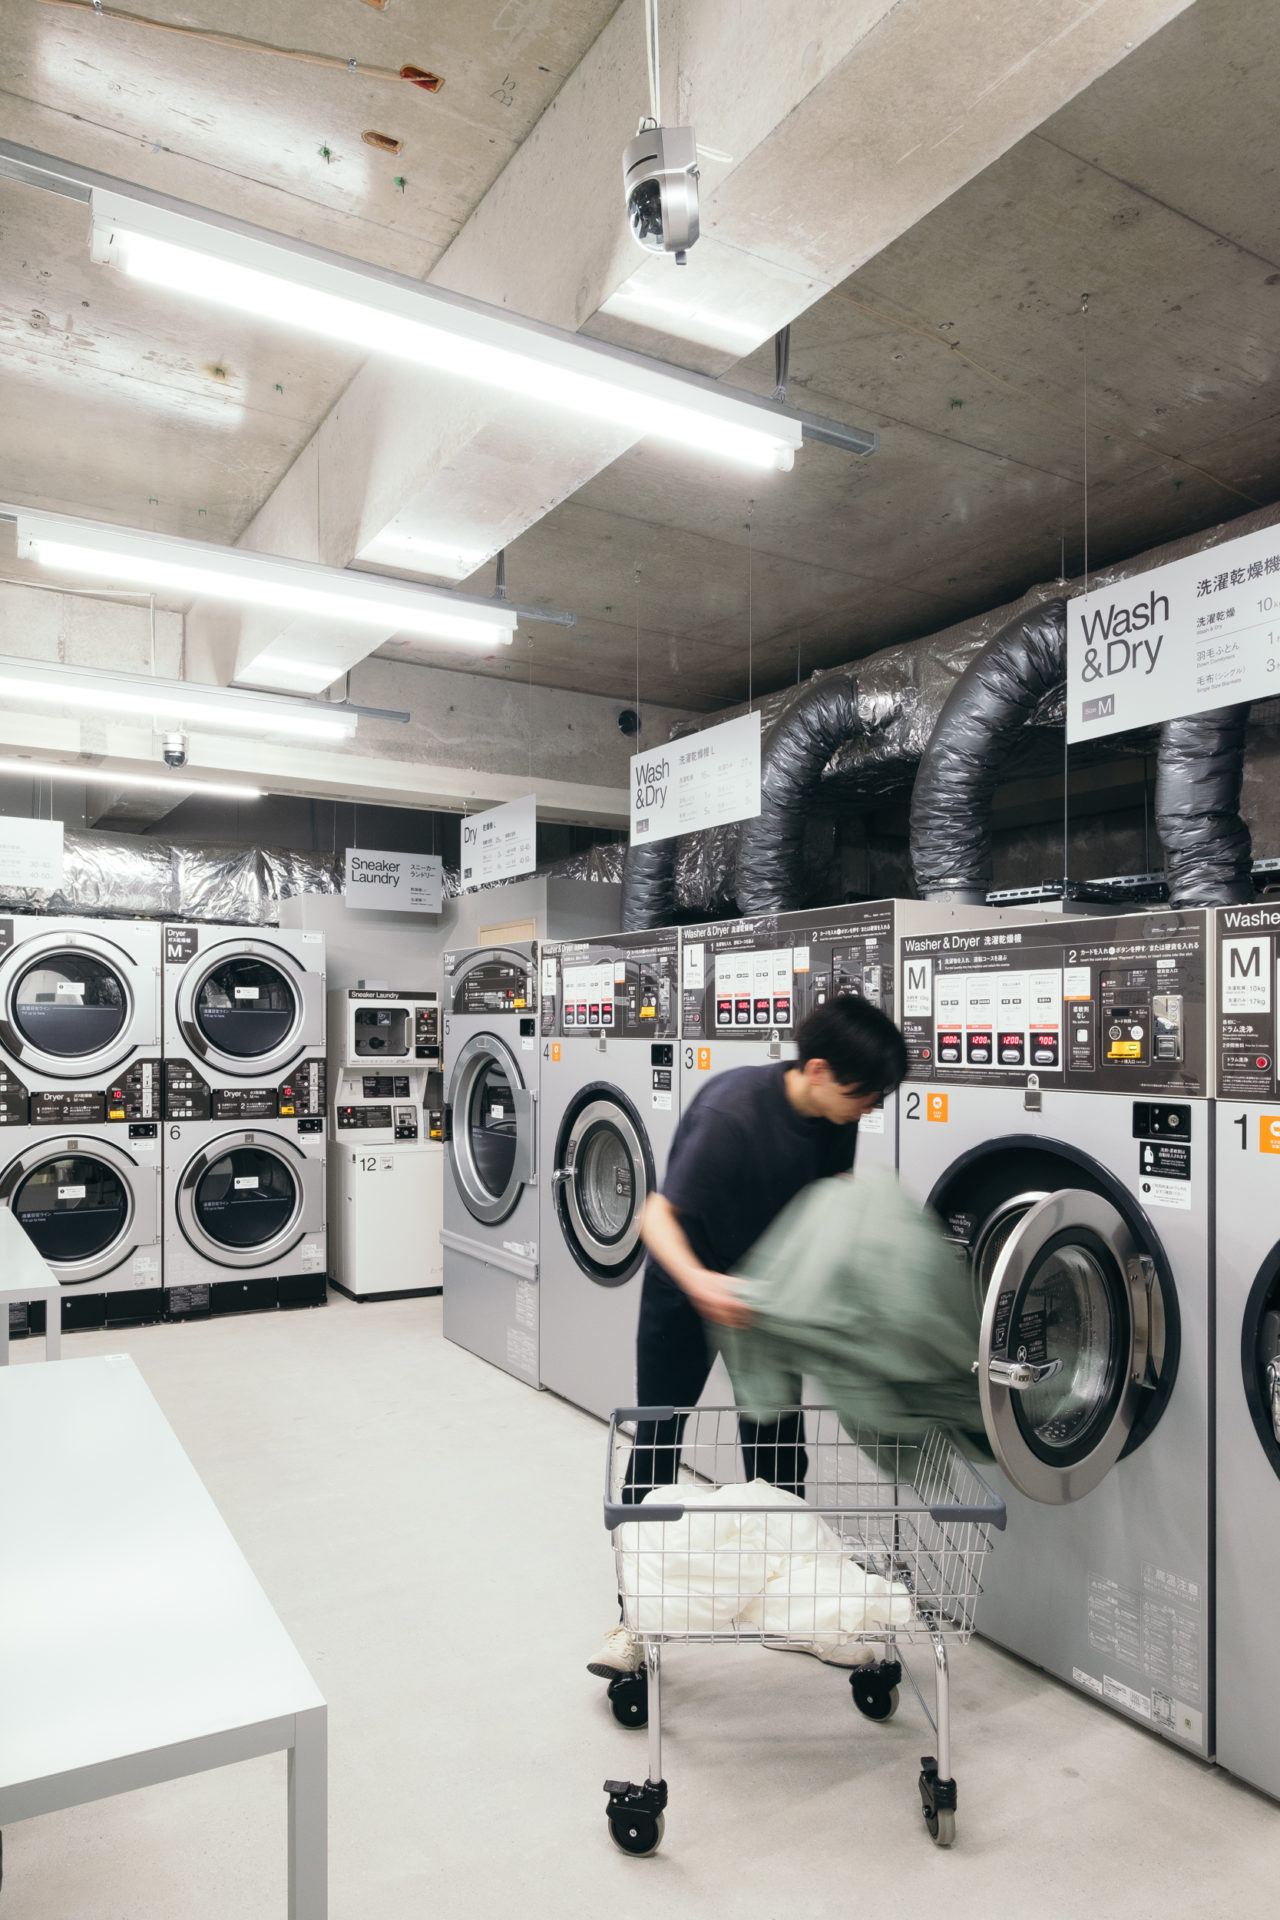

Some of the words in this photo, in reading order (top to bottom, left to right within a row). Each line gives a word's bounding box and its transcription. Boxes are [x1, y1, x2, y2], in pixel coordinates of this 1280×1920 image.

[1196, 555, 1280, 598] 洗濯乾燥機
[1081, 591, 1169, 645] Wash
[1197, 642, 1239, 661] 羽毛ふとん
[1098, 699, 1111, 715] M
[636, 758, 669, 786] Wash
[464, 827, 477, 845] Dry
[351, 857, 400, 872] Sneaker
[351, 870, 400, 887] Laundry
[410, 871, 435, 879] ランドリー
[168, 929, 186, 938] Dryer
[684, 929, 706, 939] Washer
[706, 927, 712, 937] &
[712, 926, 730, 937] Dryer
[812, 931, 818, 942] 2
[168, 944, 182, 958] M
[905, 938, 941, 952] Washer
[943, 937, 950, 949] &
[952, 936, 980, 950] Dryer
[984, 934, 1022, 946] 洗濯乾燥機
[690, 949, 697, 967] L
[1068, 950, 1077, 963] 2
[1230, 947, 1260, 978] M
[547, 963, 552, 978] L
[938, 960, 942, 971] 1
[908, 966, 926, 990] M
[445, 1020, 450, 1035] 5
[543, 1043, 550, 1061] 4
[685, 1047, 694, 1069] 3
[44, 1093, 64, 1102] Dryer
[223, 1091, 242, 1099] Dryer
[906, 1092, 920, 1120] 2
[170, 1125, 180, 1140] 6
[1234, 1114, 1247, 1150] 1
[360, 1157, 376, 1171] 12
